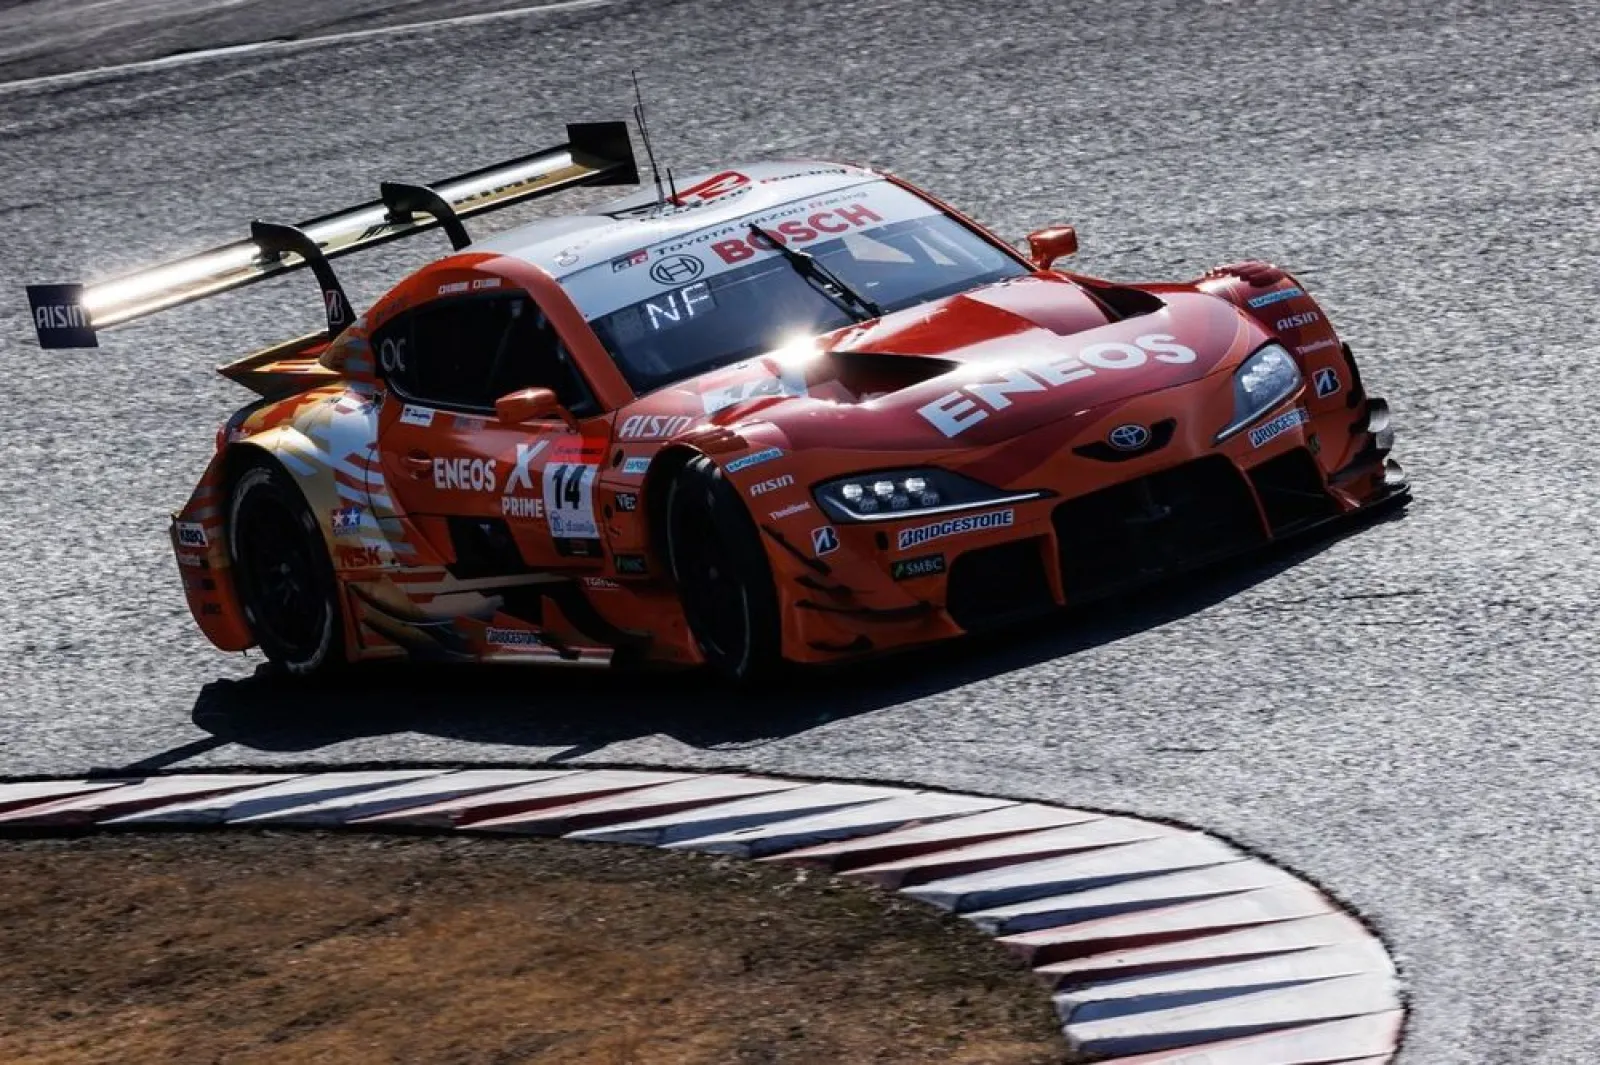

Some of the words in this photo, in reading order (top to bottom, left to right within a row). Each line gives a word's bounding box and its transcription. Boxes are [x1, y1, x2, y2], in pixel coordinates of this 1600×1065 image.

[654, 226, 735, 256] TOYOTA
[709, 203, 884, 265] BOSCH
[646, 282, 710, 330] NF
[1276, 311, 1319, 331] AISIN
[916, 333, 1198, 438] ENEOS
[619, 415, 691, 438] AISIN
[433, 457, 497, 493] ENEOS
[503, 439, 550, 494] X
[552, 464, 588, 511] 14
[750, 475, 794, 497] AISIN
[501, 497, 544, 519] PRIME
[899, 510, 1013, 548] BRIDGESTONE
[905, 560, 944, 575] SMBC
